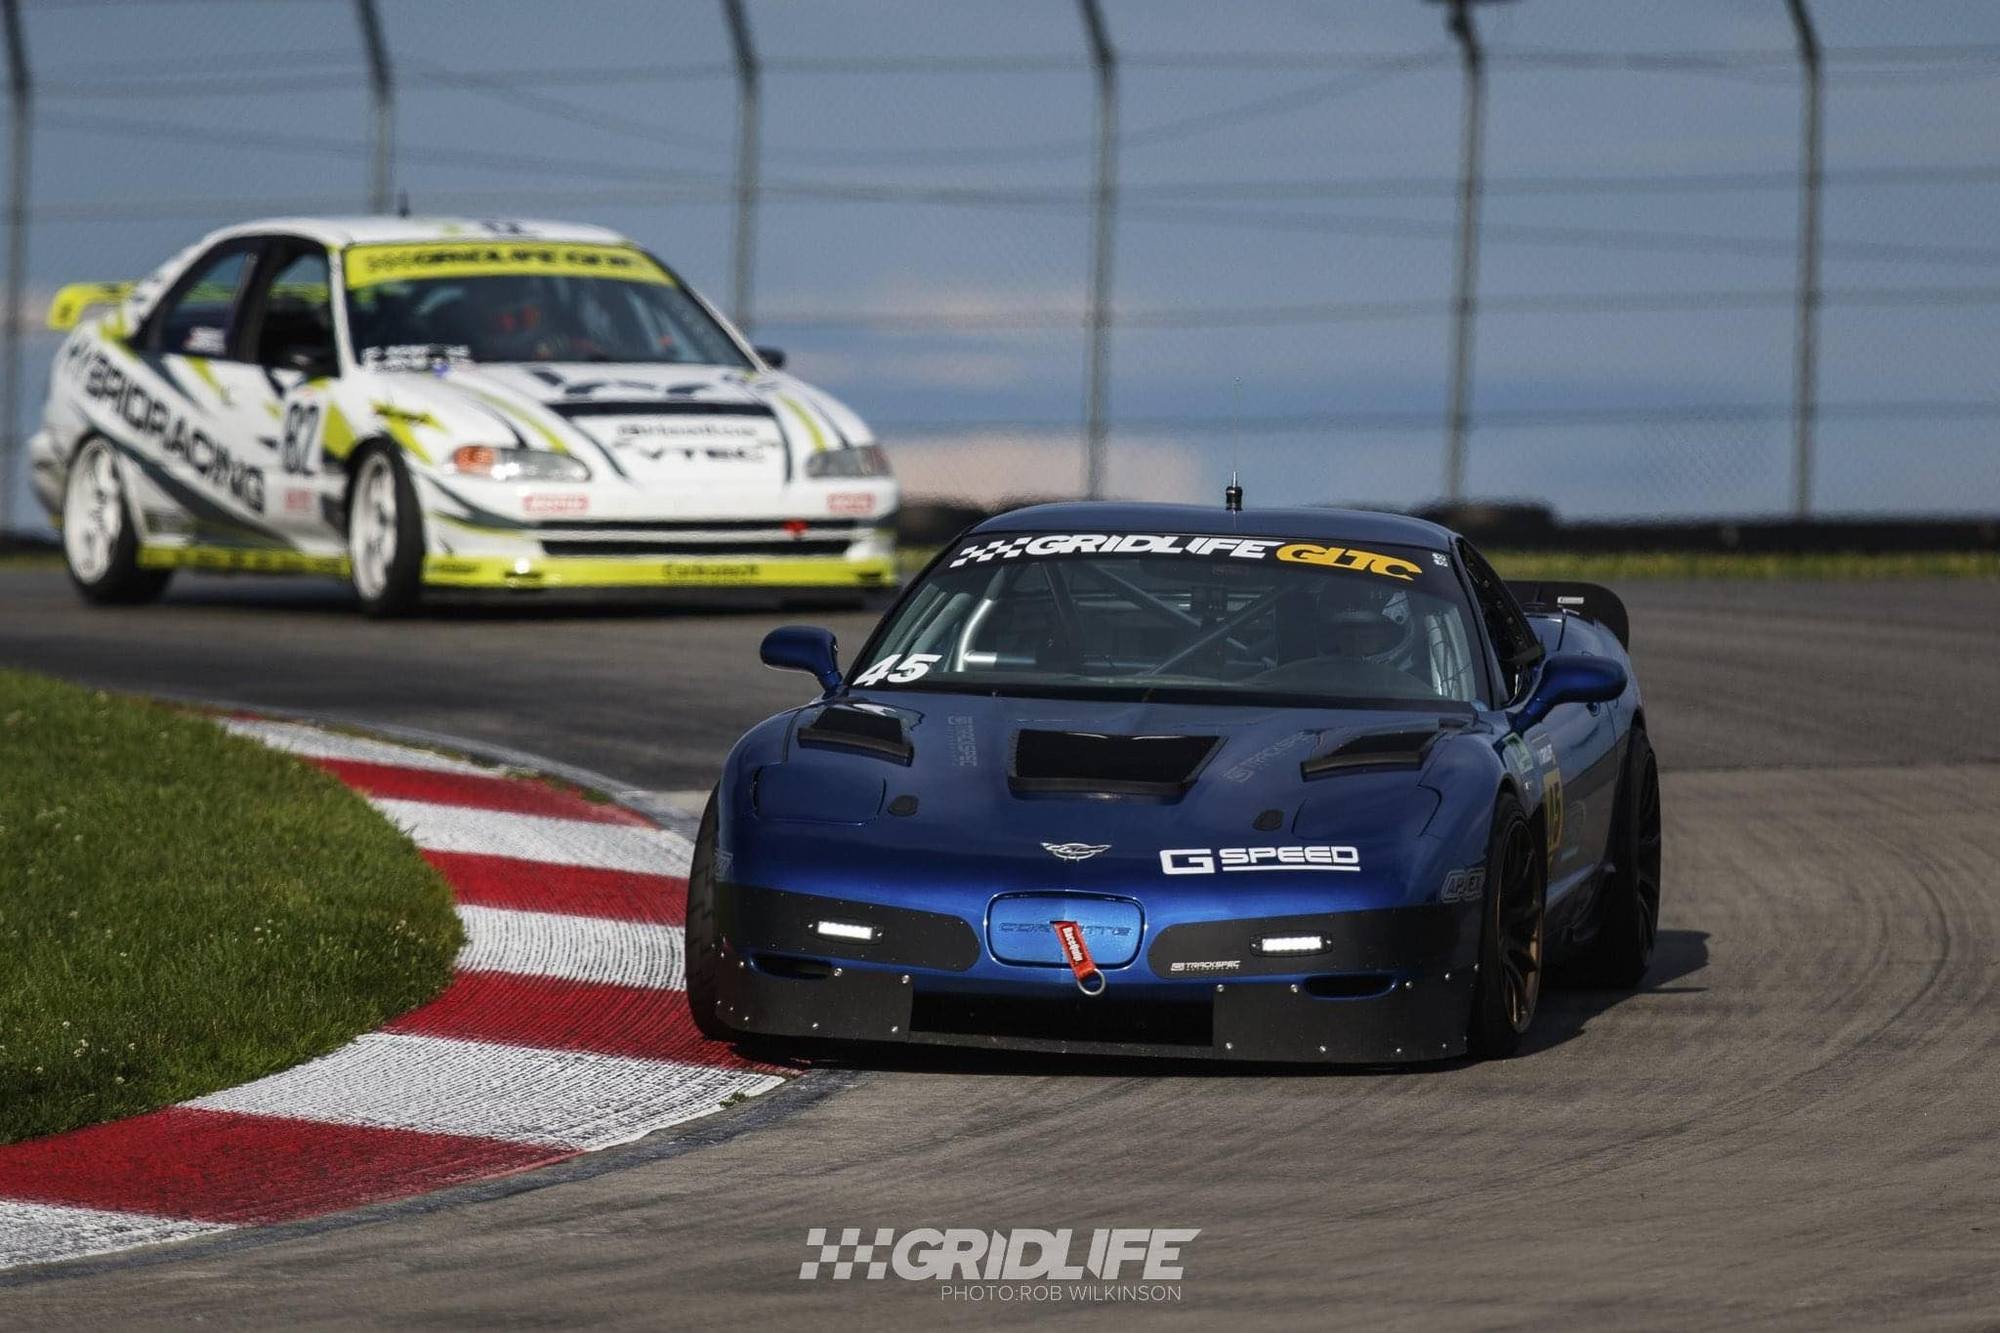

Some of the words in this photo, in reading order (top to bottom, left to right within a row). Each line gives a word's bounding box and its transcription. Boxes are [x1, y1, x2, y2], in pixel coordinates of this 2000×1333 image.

[1023, 534, 1286, 559] GRIDLIFE
[1275, 543, 1424, 581] GLTC
[852, 653, 943, 688] 45
[1159, 848, 1217, 875] G
[1220, 845, 1360, 865] SPEED
[1000, 921, 1132, 937] CORTTE
